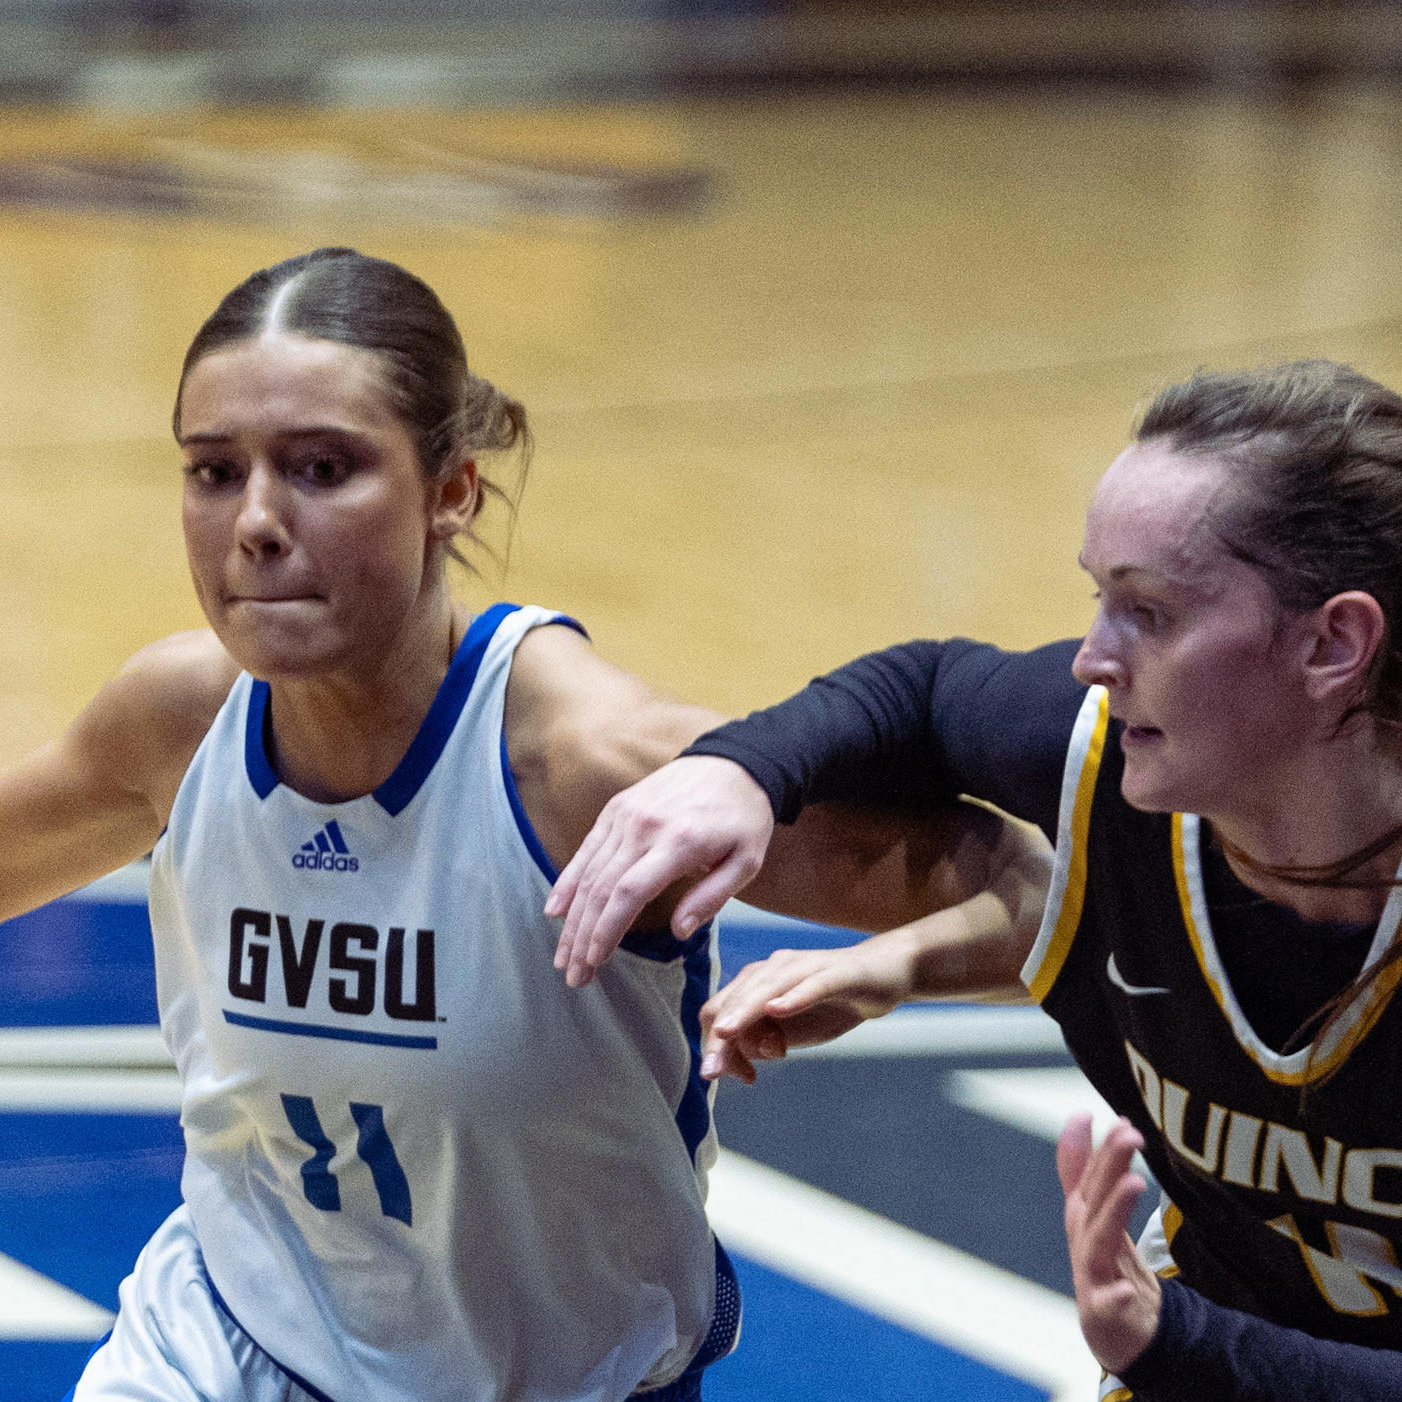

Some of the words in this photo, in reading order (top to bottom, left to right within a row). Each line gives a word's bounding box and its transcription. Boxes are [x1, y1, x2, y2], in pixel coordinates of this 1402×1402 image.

[292, 851, 360, 873] adidas
[227, 906, 437, 1022] GVSU
[279, 1093, 413, 1228] 11
